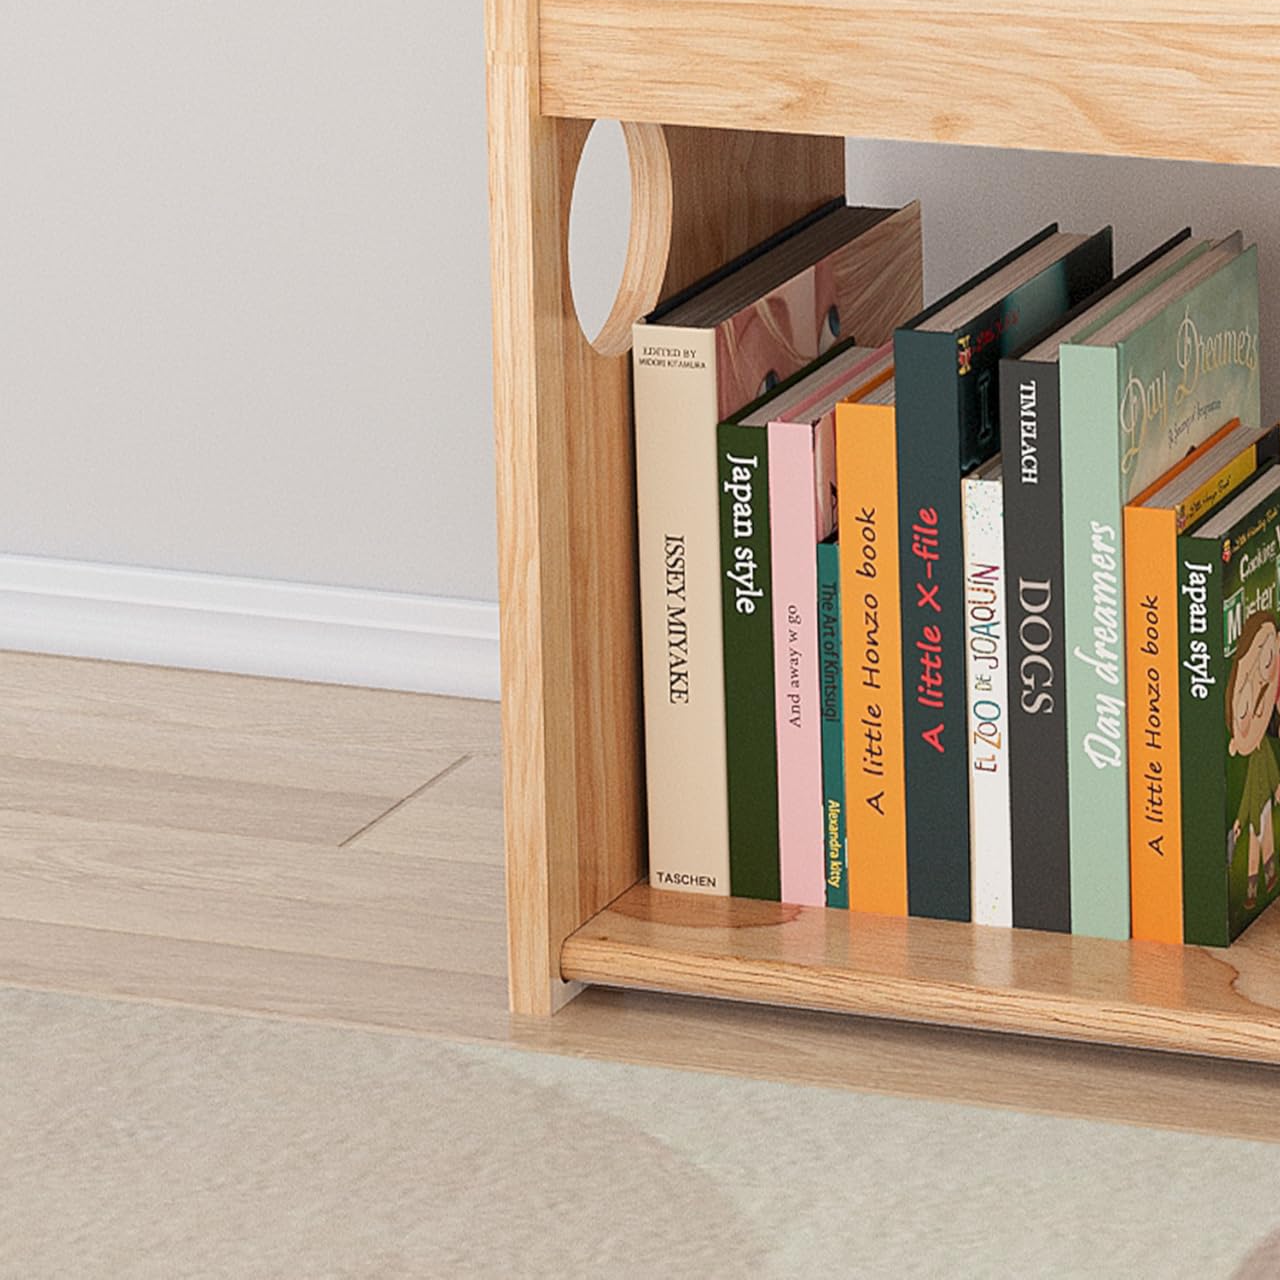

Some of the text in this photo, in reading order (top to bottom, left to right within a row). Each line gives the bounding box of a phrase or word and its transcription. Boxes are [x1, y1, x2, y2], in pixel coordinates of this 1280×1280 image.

[683, 349, 697, 358] BY
[1119, 368, 1169, 475] Day
[724, 452, 764, 615] Japan style
[787, 604, 802, 625] go
[822, 581, 837, 611] The
[664, 534, 690, 704] ISSEY MIYAKE
[822, 613, 838, 637] Art
[1182, 561, 1216, 700] Japan style
[823, 641, 839, 658] of
[855, 507, 885, 816] A little Honzo book
[1018, 577, 1055, 715] DOGS
[1074, 521, 1126, 770] Day dreamers
[789, 648, 803, 688] away
[917, 625, 944, 708] little
[787, 693, 802, 729] And
[1141, 594, 1165, 857] A little Honzo book
[921, 723, 945, 753] A
[974, 754, 998, 773] EL
[656, 871, 717, 887] TASCHEN
